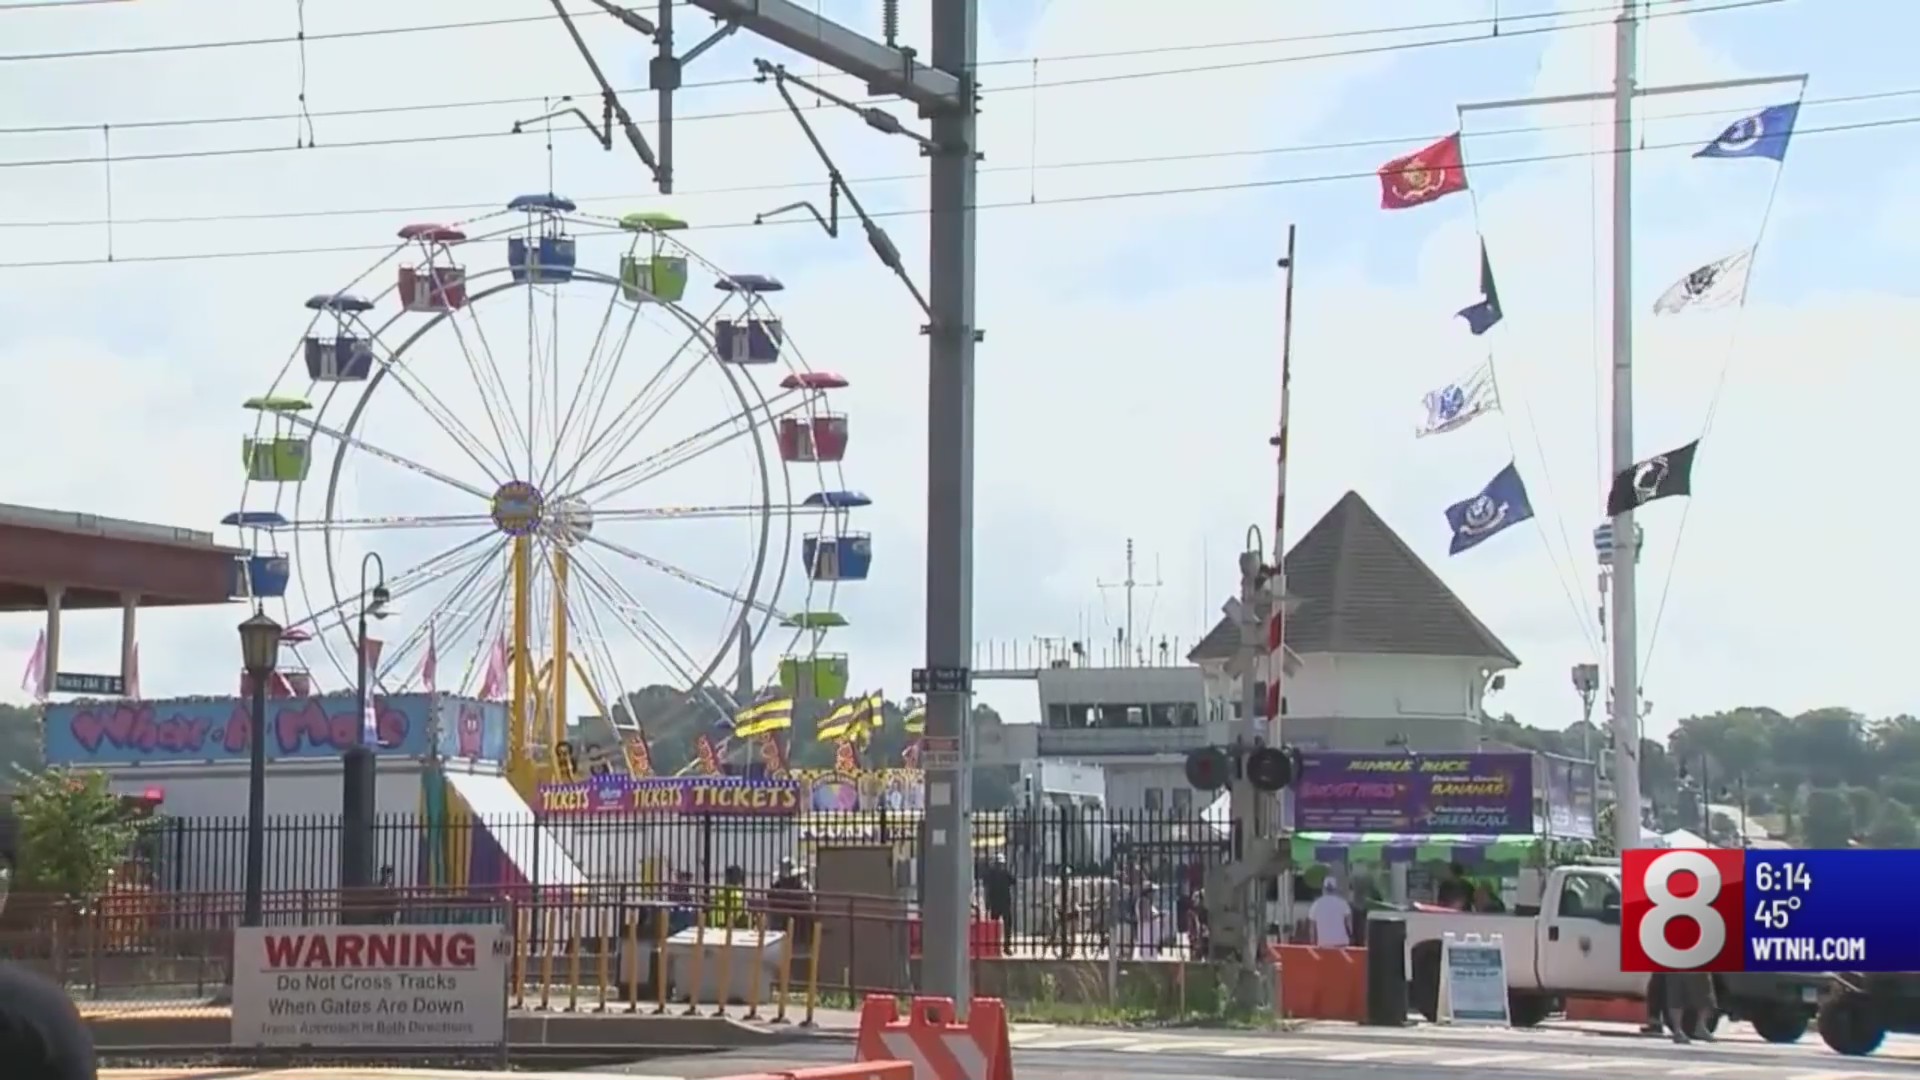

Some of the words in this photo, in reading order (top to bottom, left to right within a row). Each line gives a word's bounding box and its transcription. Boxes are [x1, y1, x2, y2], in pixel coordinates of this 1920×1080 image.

[543, 789, 590, 812] TICKETS
[633, 787, 682, 808] TICKETS
[692, 785, 797, 808] TICKETS
[264, 932, 477, 968] WARNING
[276, 974, 301, 991] Do
[305, 973, 336, 991] Not
[340, 973, 393, 991] Cross
[398, 973, 457, 991] Tracks
[268, 998, 316, 1015] When
[321, 997, 372, 1014] Gates
[376, 998, 408, 1014] Are
[411, 997, 465, 1014] Down
